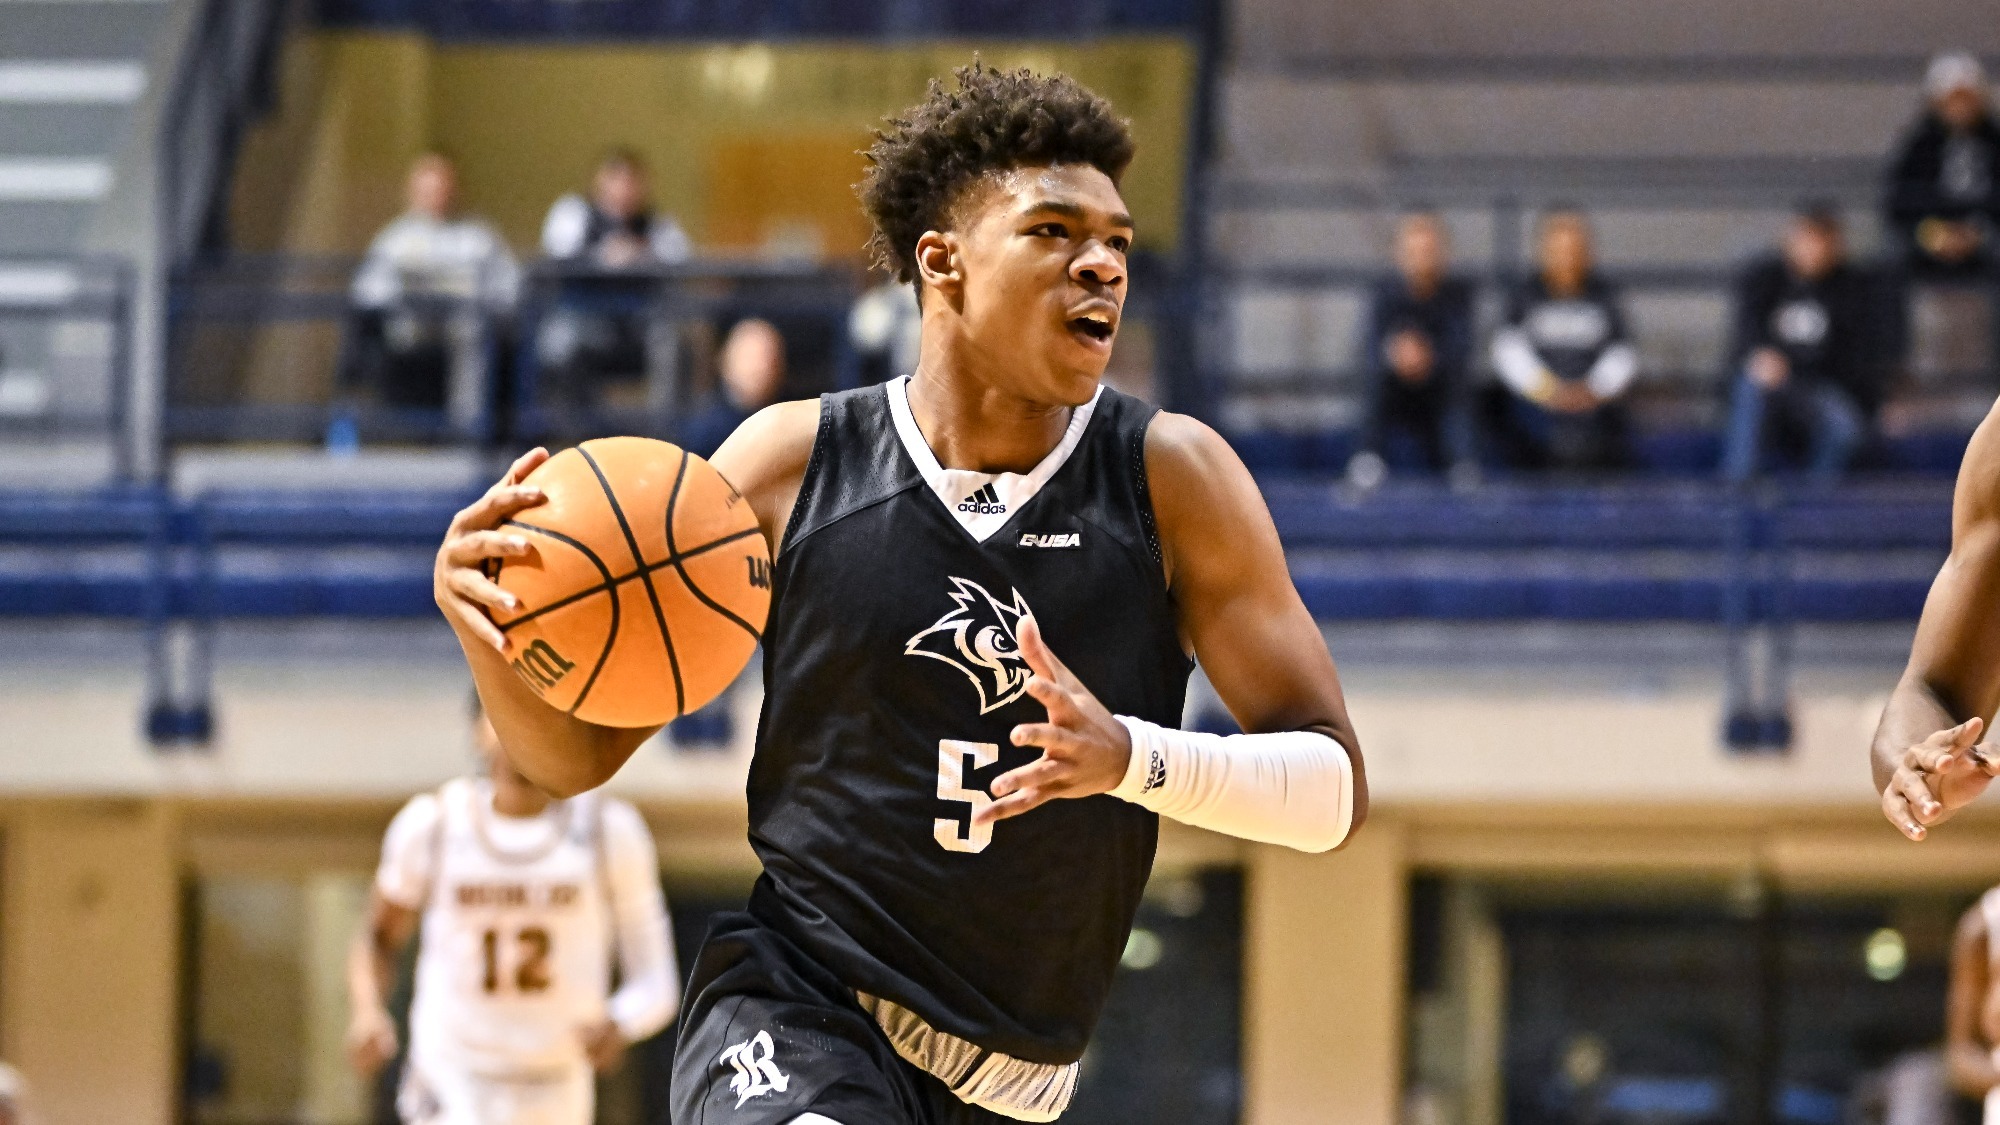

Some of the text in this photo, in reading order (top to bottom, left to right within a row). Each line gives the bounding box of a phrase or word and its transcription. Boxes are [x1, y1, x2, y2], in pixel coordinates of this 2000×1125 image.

[957, 501, 1007, 515] adidas
[934, 738, 999, 854] 5
[1140, 750, 1160, 795] adidas
[482, 927, 553, 994] 12
[719, 1029, 790, 1111] R
